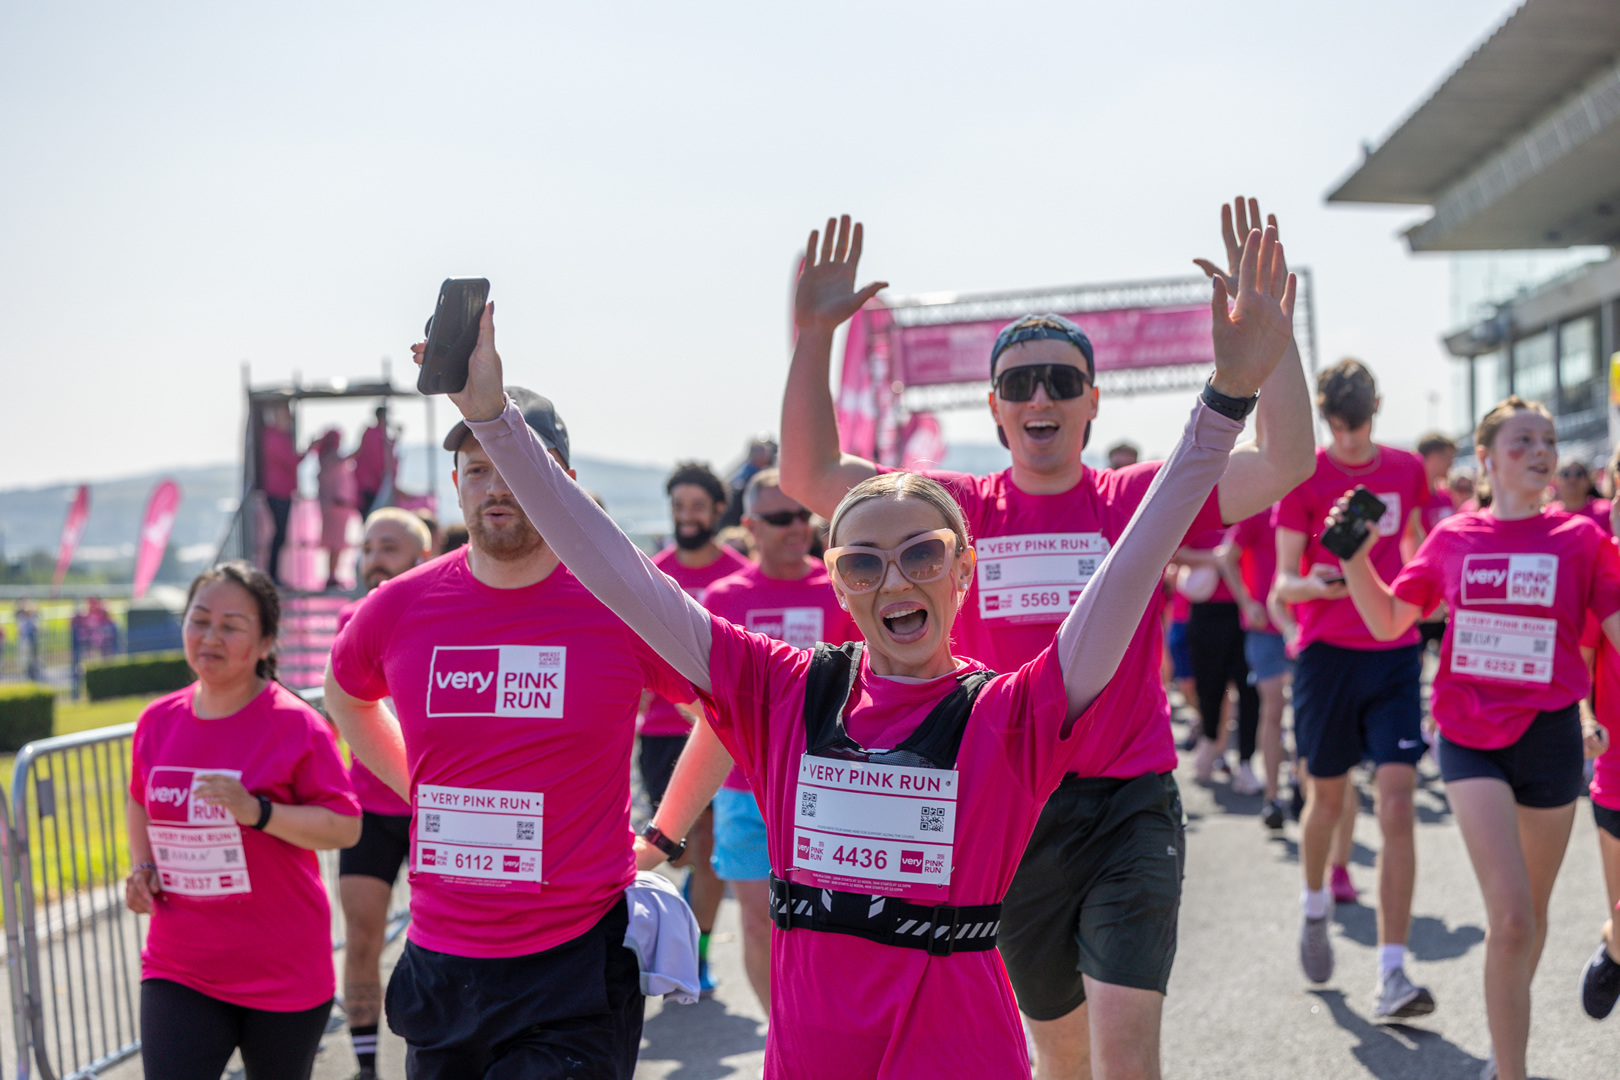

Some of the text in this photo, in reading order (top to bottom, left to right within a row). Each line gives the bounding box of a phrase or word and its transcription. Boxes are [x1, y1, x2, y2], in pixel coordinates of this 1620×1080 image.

[988, 539, 1089, 553] VERY PINK RUN
[1466, 569, 1507, 587] very
[1512, 571, 1551, 584] PINK
[1512, 585, 1545, 598] RUN
[1021, 592, 1060, 608] 5569
[436, 671, 494, 694] very
[504, 672, 558, 689] PINK
[503, 692, 551, 708] RUN
[810, 764, 940, 792] VERY PINK RUN
[150, 786, 189, 807] very
[431, 792, 530, 810] VERY PINK RUN
[194, 805, 226, 819] RUN
[158, 832, 232, 842] VERY PINK RUN
[811, 847, 824, 855] PINK
[811, 853, 822, 861] RUN
[832, 845, 887, 870] 4436
[455, 853, 493, 870] 6112
[902, 858, 922, 867] very
